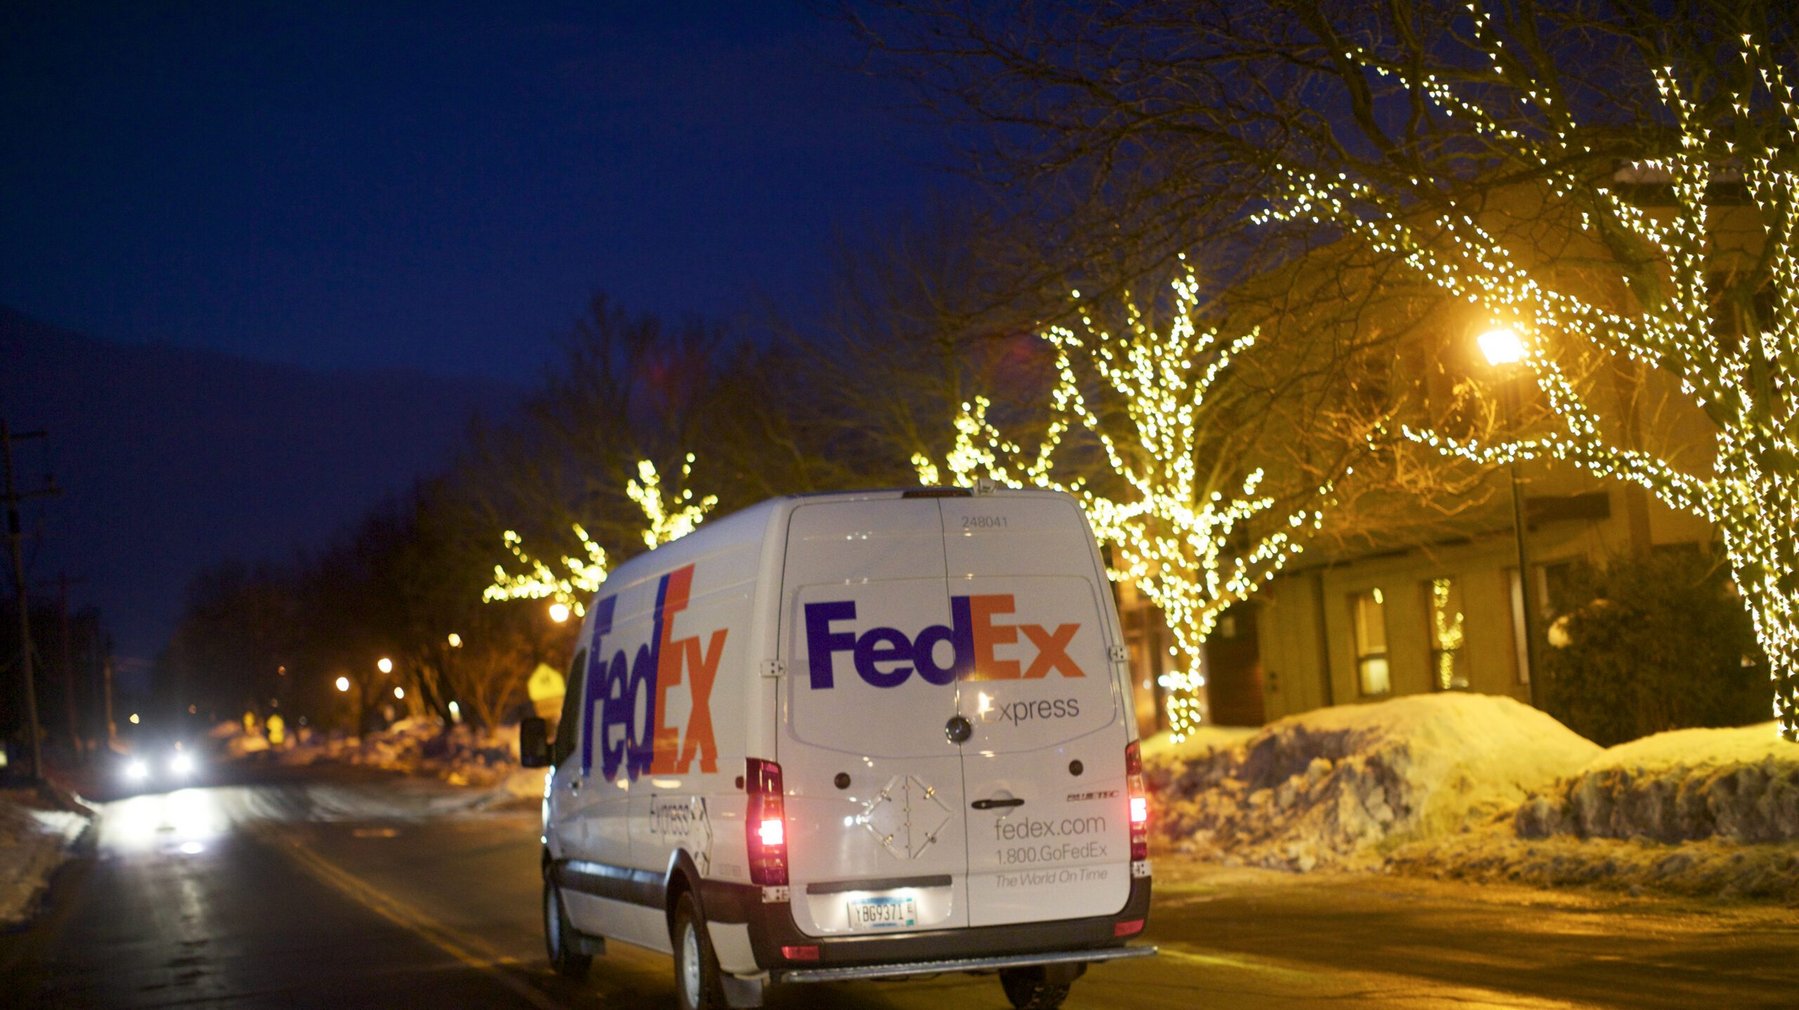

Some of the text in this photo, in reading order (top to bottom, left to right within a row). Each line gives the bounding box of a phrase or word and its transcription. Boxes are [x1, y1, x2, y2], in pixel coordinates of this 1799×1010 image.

[961, 515, 1008, 529] 248041
[804, 593, 1087, 690] FedEx
[582, 562, 729, 784] FedEx
[979, 698, 1080, 727] xpress
[994, 816, 1107, 841] fedex.com
[996, 841, 1108, 865] 1.800.GoFedEx
[996, 867, 1109, 888] The World On Time
